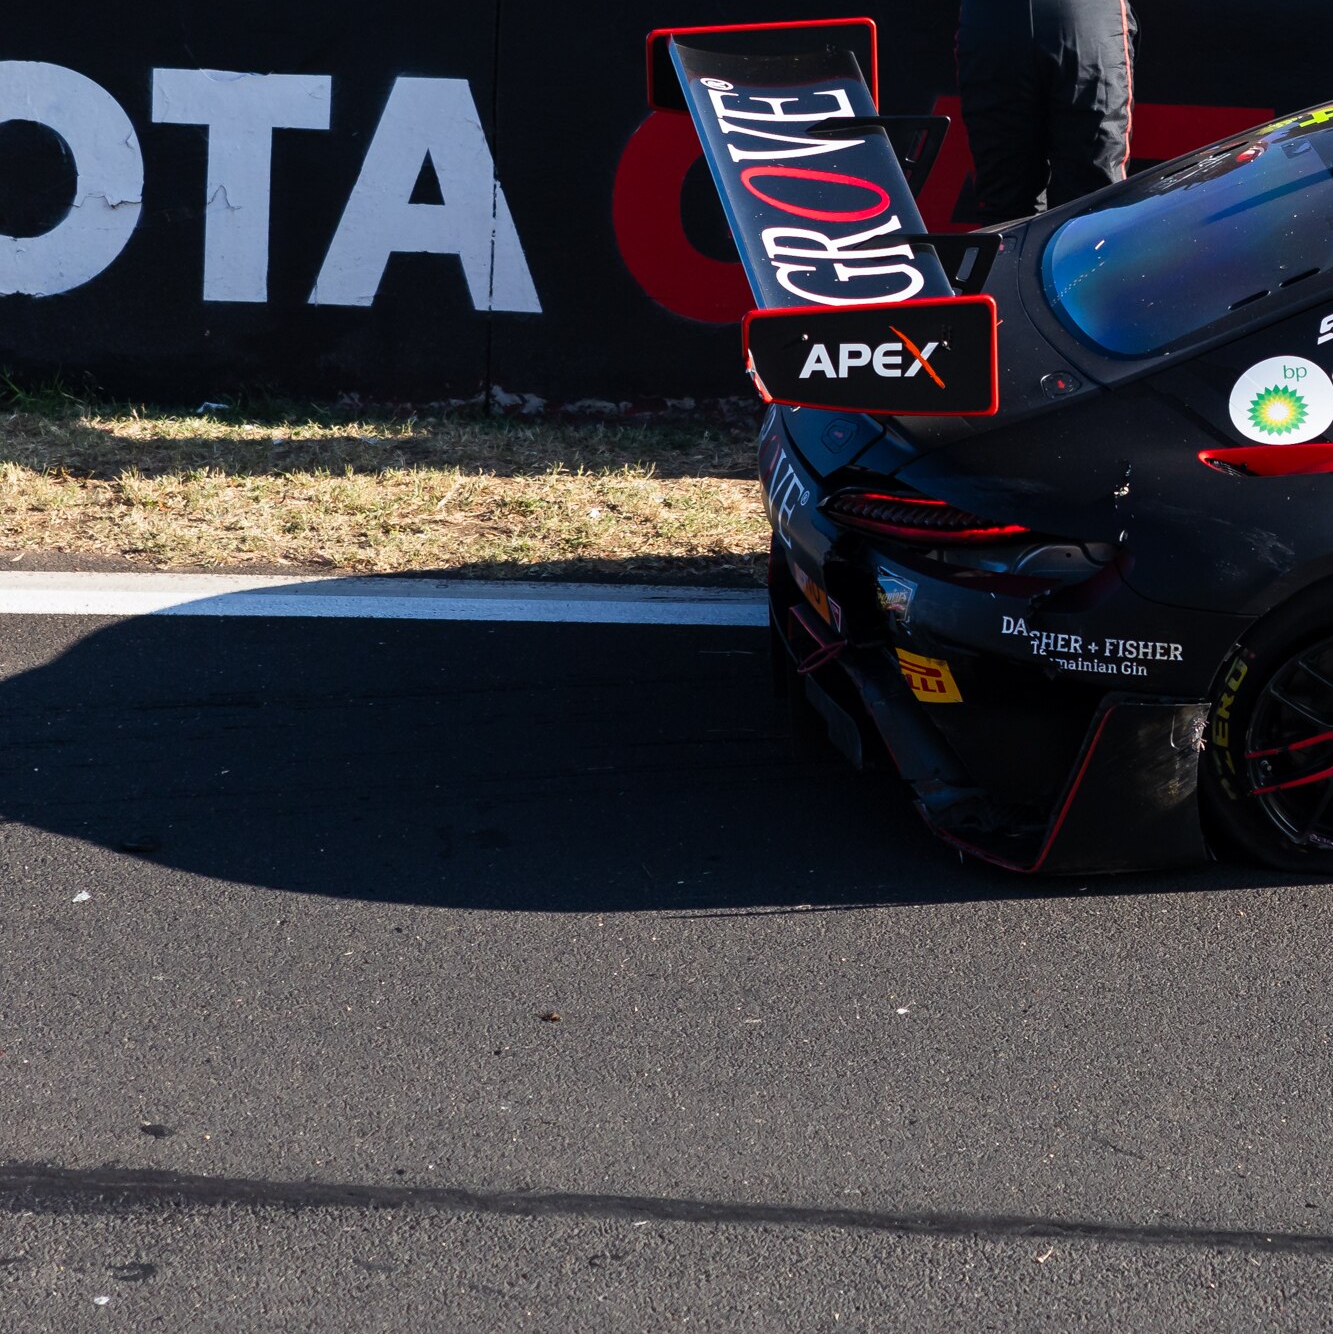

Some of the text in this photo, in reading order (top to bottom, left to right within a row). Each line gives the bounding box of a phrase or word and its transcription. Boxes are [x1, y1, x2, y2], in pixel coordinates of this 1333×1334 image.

[799, 326, 946, 389] APEX
[1282, 363, 1308, 381] bp
[1103, 638, 1184, 662] FISHER
[1120, 661, 1148, 677] Gin
